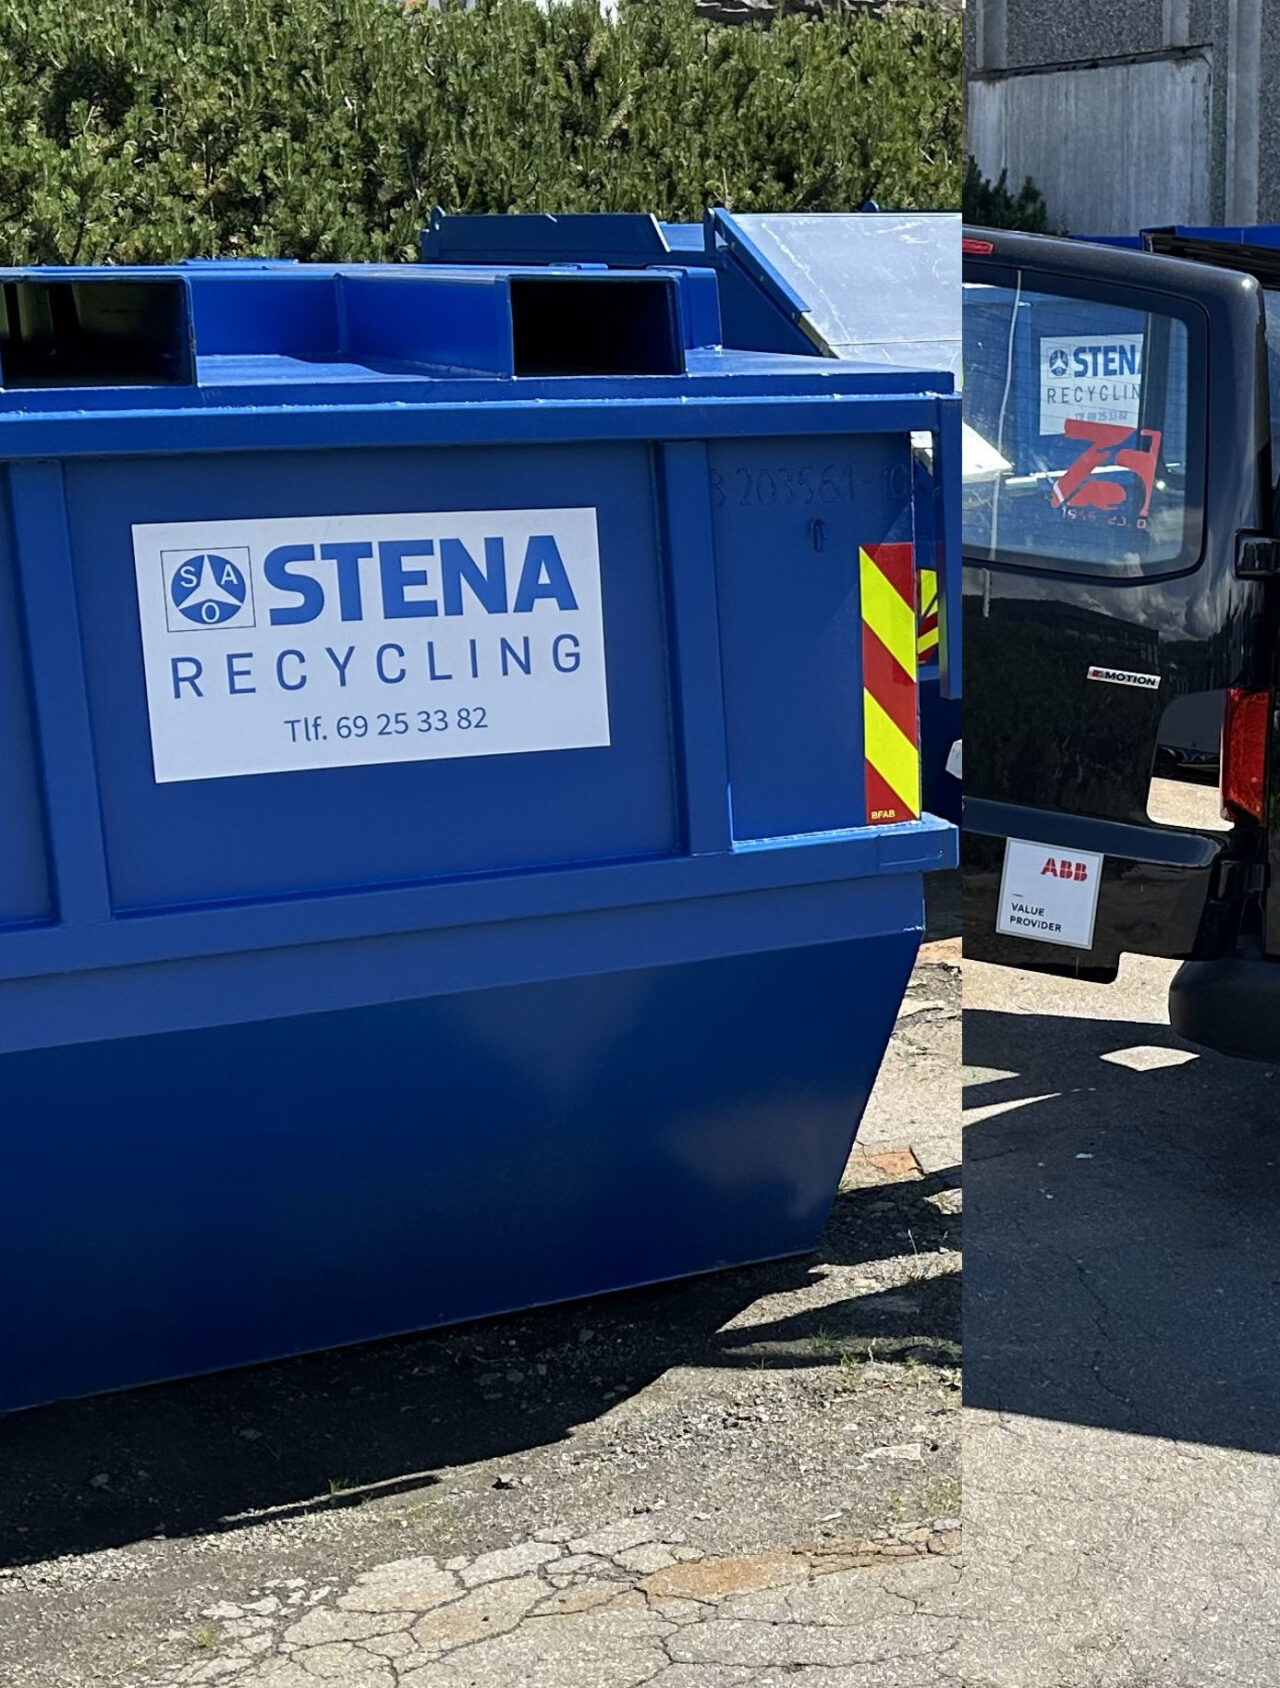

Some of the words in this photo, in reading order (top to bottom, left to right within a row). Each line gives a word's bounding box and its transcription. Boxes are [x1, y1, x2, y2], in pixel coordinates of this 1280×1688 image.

[1073, 344, 1142, 378] STEN
[1046, 383, 1140, 405] RECYCLIN
[262, 534, 580, 627] STENA
[170, 632, 582, 700] RECYCLING
[283, 715, 328, 743] Tlf.
[336, 715, 369, 740] 69
[375, 712, 410, 736] 25
[416, 709, 449, 733] 33
[456, 706, 489, 730] 82
[1040, 857, 1088, 882] ABB
[1008, 915, 1063, 933] PROVIDER
[1011, 902, 1045, 917] VALUE
